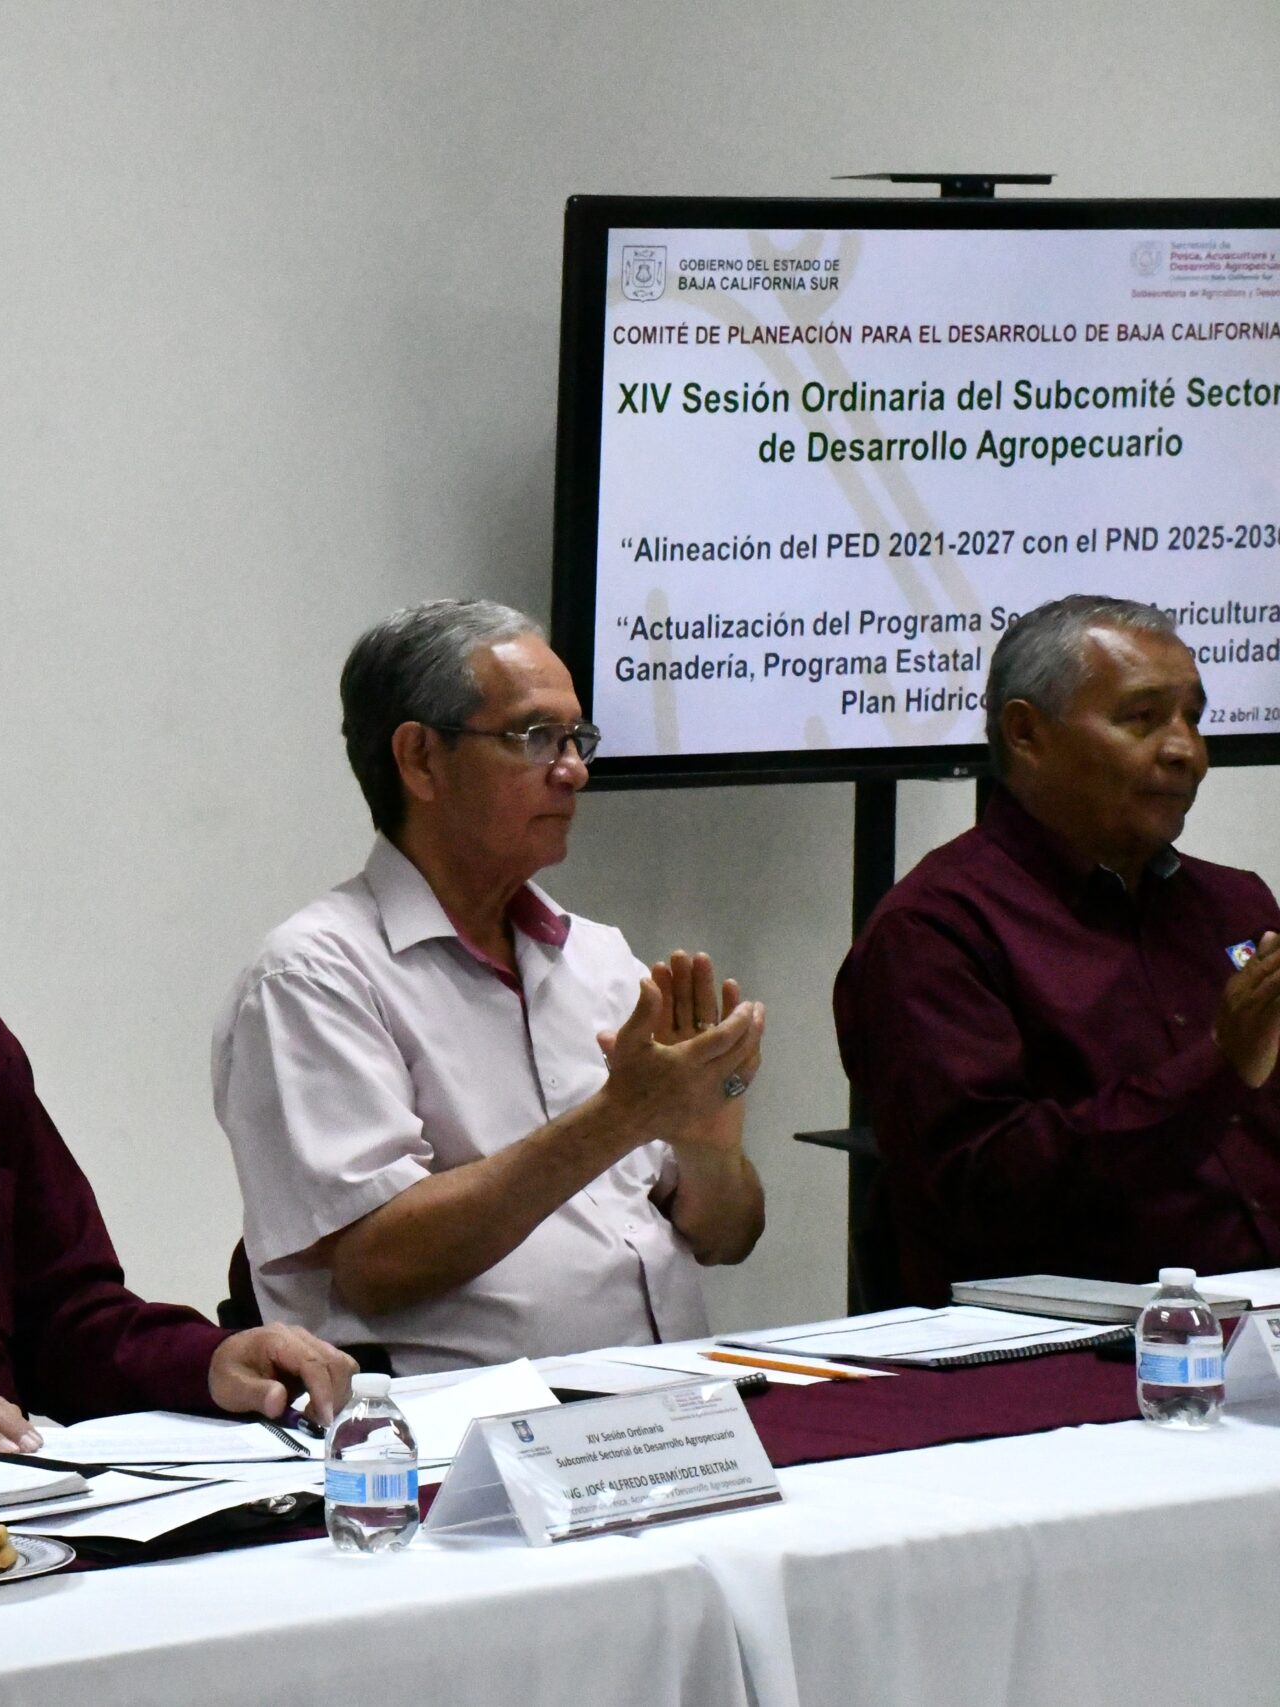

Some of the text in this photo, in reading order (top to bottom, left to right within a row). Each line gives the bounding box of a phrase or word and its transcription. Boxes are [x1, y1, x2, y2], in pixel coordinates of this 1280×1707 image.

[678, 258, 841, 271] GOBIERNO DEL ESTADO DE
[677, 276, 839, 291] BAJA CALIFORNIA SUR
[613, 321, 1280, 345] COMITÉ DE PLANEACIÓN PARA EL DESARROLLO DE BAJA CALIFORNIA
[618, 382, 672, 414] XIV
[682, 381, 789, 414] Sesión
[802, 380, 945, 413] Ordinaria
[957, 379, 1002, 411] del
[1013, 377, 1175, 411] Subcomité
[759, 427, 1183, 468] de Desarrollo Agropecuario
[780, 534, 818, 559] del
[827, 532, 880, 558] PED
[889, 530, 1015, 557] 2021-2027
[1023, 533, 1067, 554] con
[1076, 528, 1097, 553] el
[1106, 526, 1159, 551] PND
[1168, 524, 1280, 551] 2025-203
[812, 610, 850, 636] del
[859, 609, 982, 640] Programa
[615, 653, 755, 682] Ganadería,
[764, 651, 887, 683] Programa
[896, 646, 981, 673] Estatal
[841, 689, 896, 715] Plan
[1210, 708, 1225, 723] 22
[1229, 707, 1260, 723] abril
[586, 1423, 664, 1444] XIV Sesión Ordinaria
[556, 1452, 599, 1468] Subcomité
[599, 1446, 632, 1461] Sectorial
[632, 1444, 643, 1455] de
[642, 1438, 685, 1453] Desarrollo
[685, 1430, 735, 1448] Agropecuario
[699, 1458, 739, 1477] BELTRÁN
